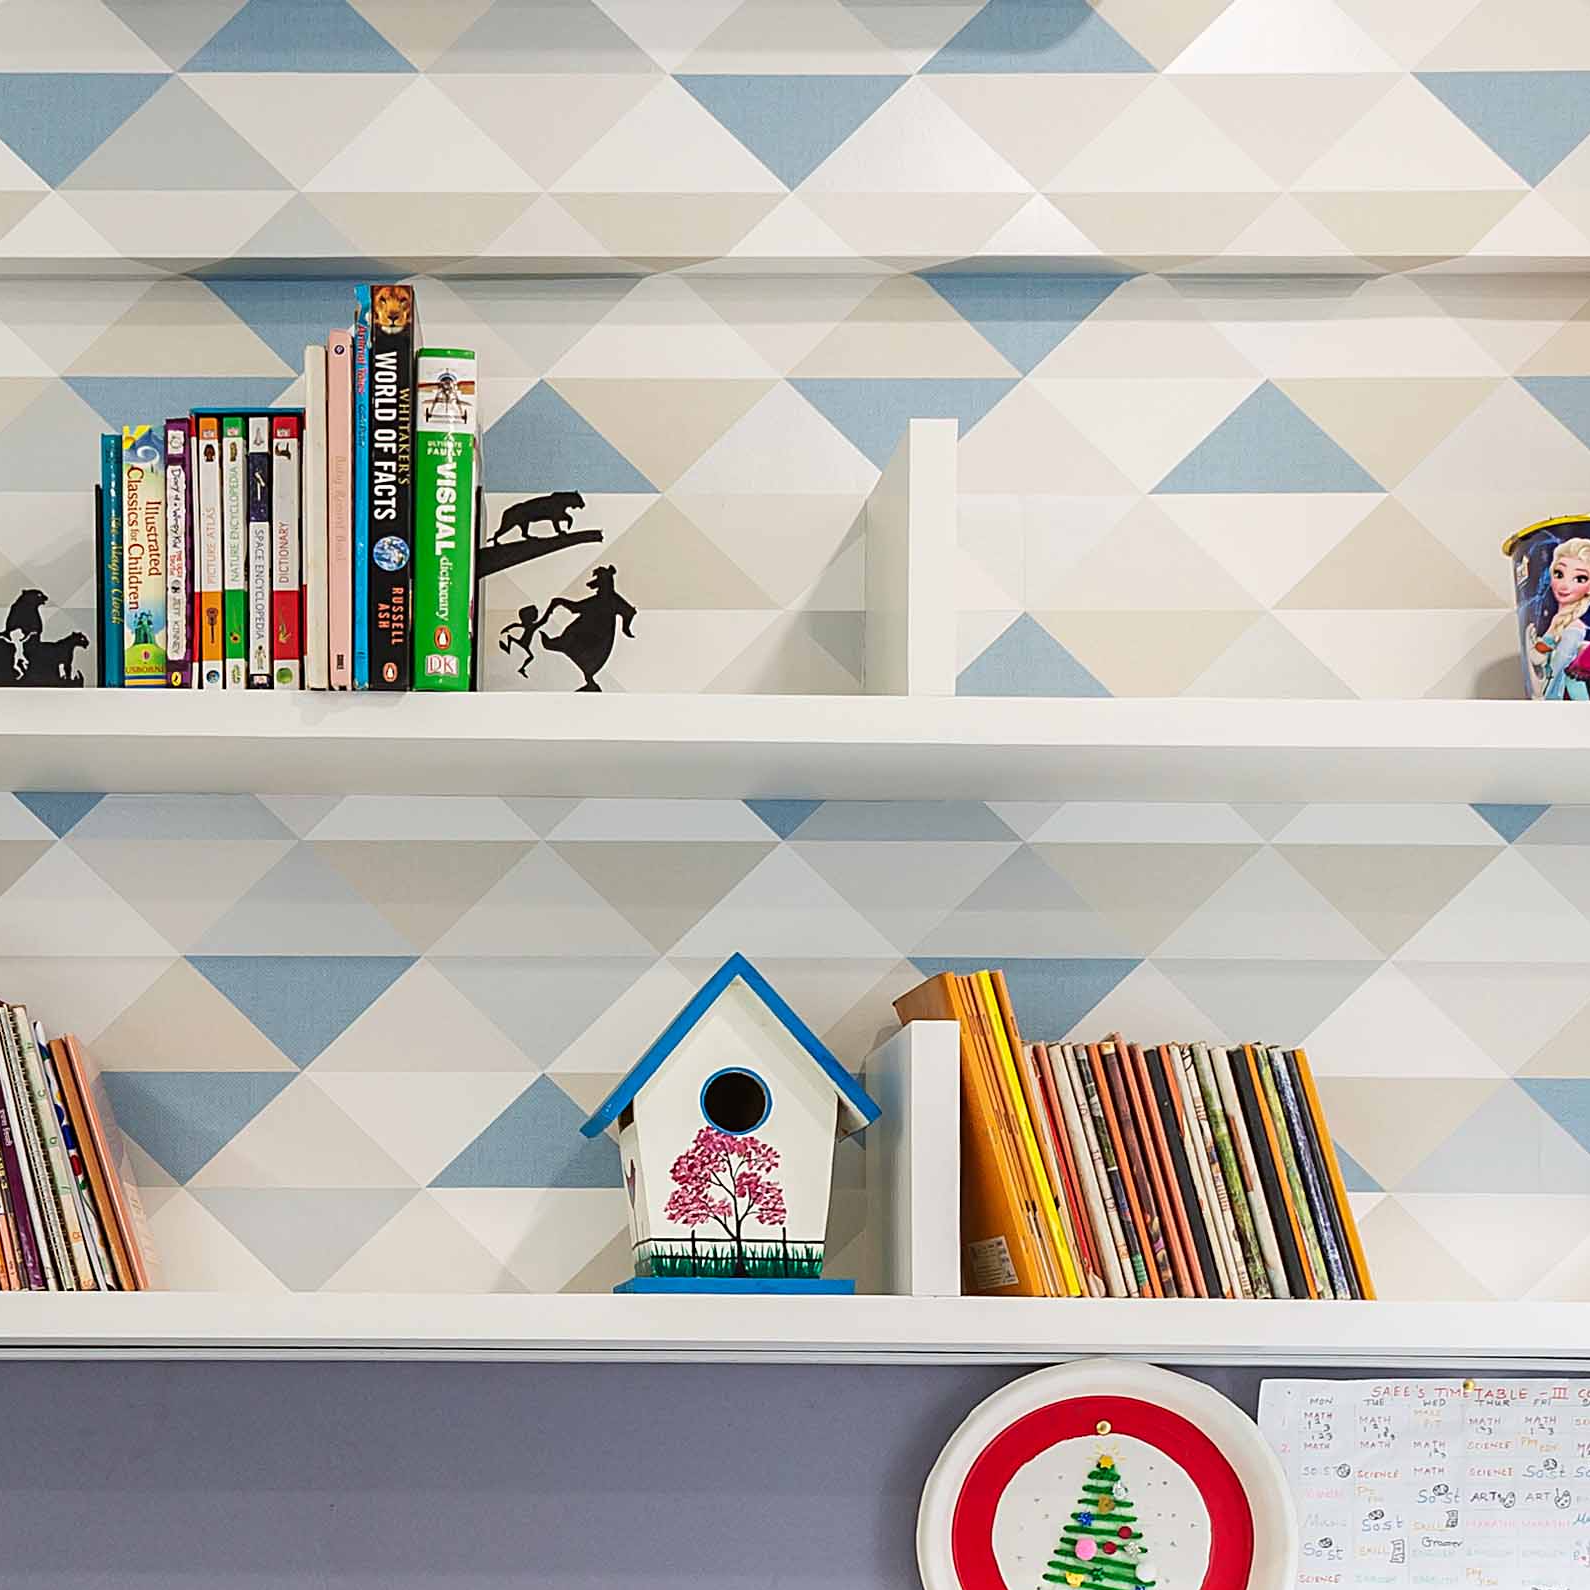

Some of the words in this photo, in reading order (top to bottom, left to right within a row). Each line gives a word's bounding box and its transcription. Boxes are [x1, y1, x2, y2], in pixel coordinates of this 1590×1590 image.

[357, 325, 367, 364] Animal
[373, 351, 397, 425] WORLD
[374, 430, 397, 452] OF
[397, 388, 410, 486] WHITAKER'S
[171, 468, 181, 491] Diary
[374, 460, 397, 521] FACTS
[127, 467, 143, 526] Classics
[230, 467, 239, 538] ENCYCLOPEDIA
[435, 462, 458, 556] VISUAL
[131, 529, 139, 541] for
[171, 509, 181, 535] Wimpy
[146, 501, 162, 577] Illustrated
[173, 536, 181, 548] Kid
[255, 529, 265, 560] SPACE
[279, 522, 290, 584] DICTIONARY
[128, 544, 144, 610] Children
[230, 542, 239, 582] NATURE
[255, 564, 265, 640] ENCYCLOPEDIA
[435, 556, 451, 622] dictionary
[172, 597, 181, 618] JEFF
[377, 603, 390, 629] ASH
[390, 586, 404, 646] RUSSELL
[172, 620, 181, 656] KINNEY
[427, 654, 458, 675] DK
[1371, 1385, 1426, 1399] SAEE'S
[1552, 1387, 1569, 1399] III
[1422, 1399, 1446, 1407] WED
[1360, 1415, 1391, 1423] MATH
[1469, 1417, 1501, 1425] MATH
[1524, 1416, 1557, 1424] MATH
[1304, 1441, 1330, 1449] MATH
[1360, 1441, 1391, 1449] MATH
[1413, 1440, 1446, 1448] MATH
[1467, 1441, 1511, 1450] SCIENCE
[1357, 1470, 1400, 1479] SCIENCE
[1413, 1467, 1445, 1475] MATH
[1469, 1468, 1514, 1477] SCIENCE
[1470, 1492, 1498, 1502] ART
[1525, 1492, 1550, 1501] ART
[1299, 1574, 1341, 1584] SCIENCE
